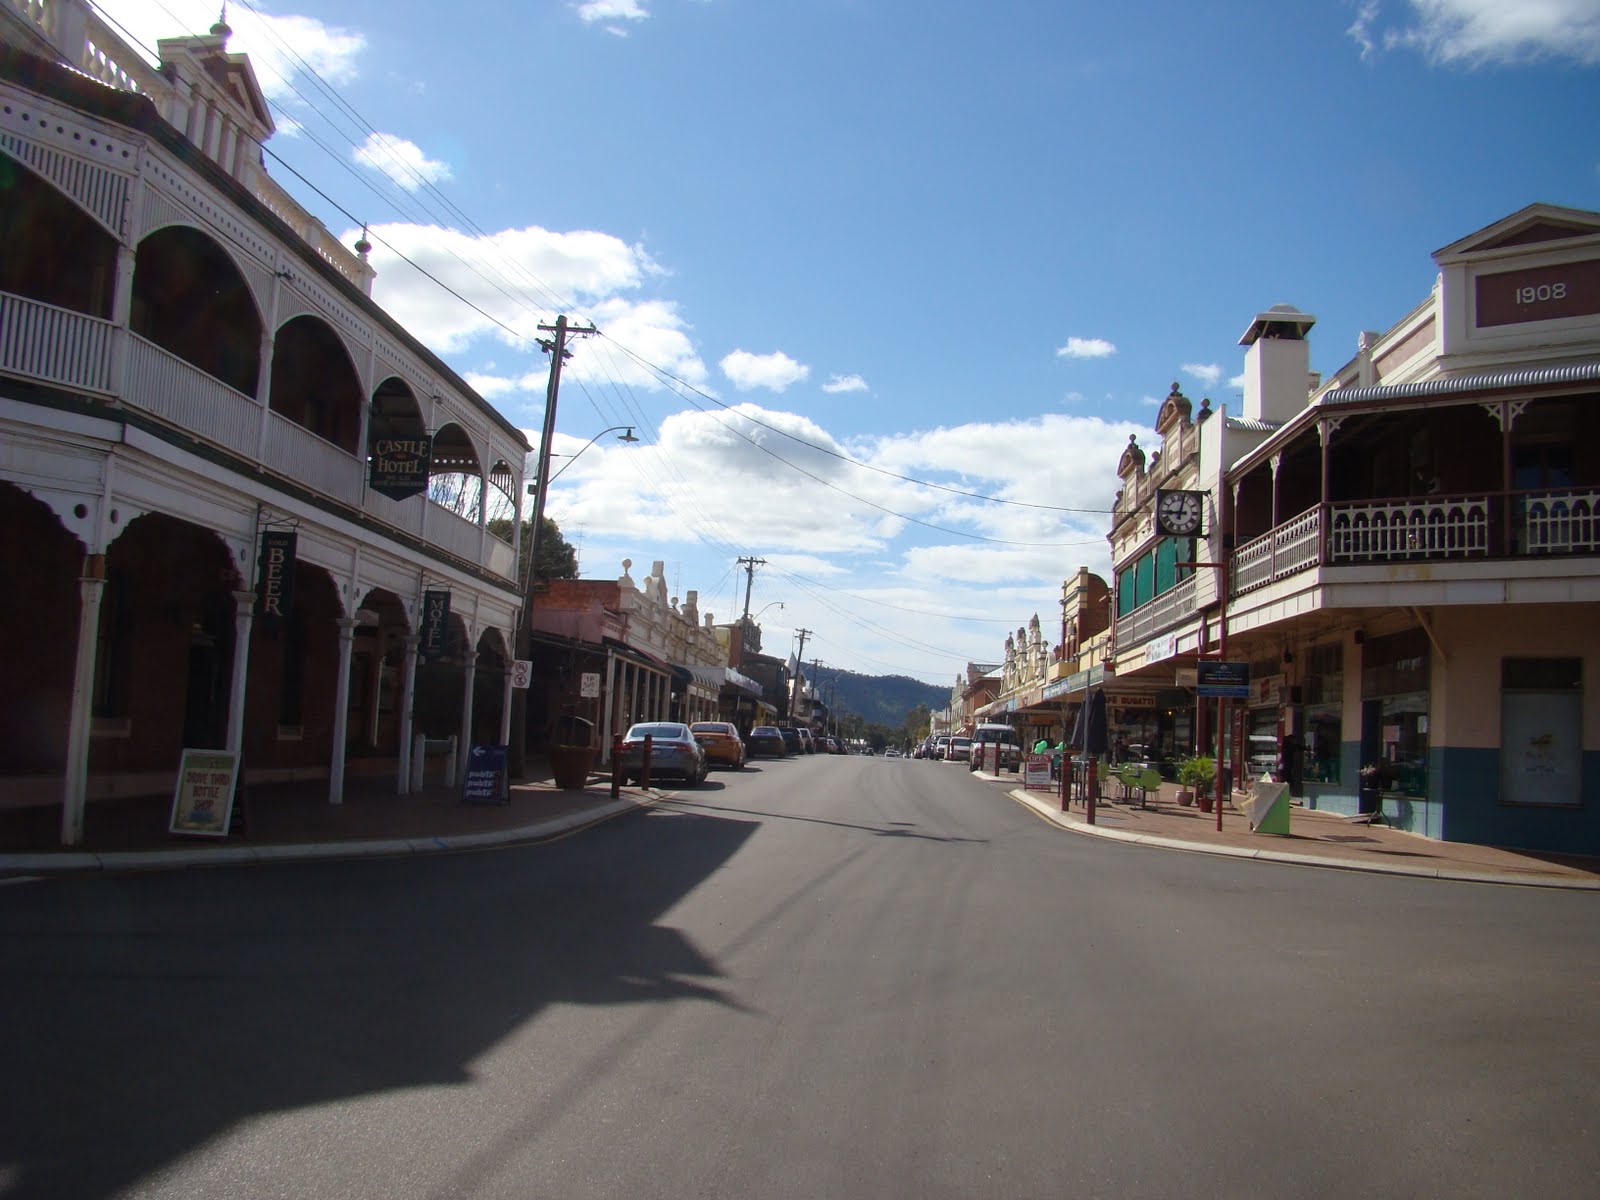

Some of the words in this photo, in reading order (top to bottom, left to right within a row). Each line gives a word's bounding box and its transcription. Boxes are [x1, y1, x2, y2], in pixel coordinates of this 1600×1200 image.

[1516, 283, 1566, 304] 1908
[376, 439, 429, 457] CASTLE
[378, 457, 424, 474] HOTEL
[264, 548, 285, 616] BEER
[428, 600, 445, 648] MOTEL
[186, 771, 209, 784] DRIVE
[193, 785, 220, 797] BOTTLE
